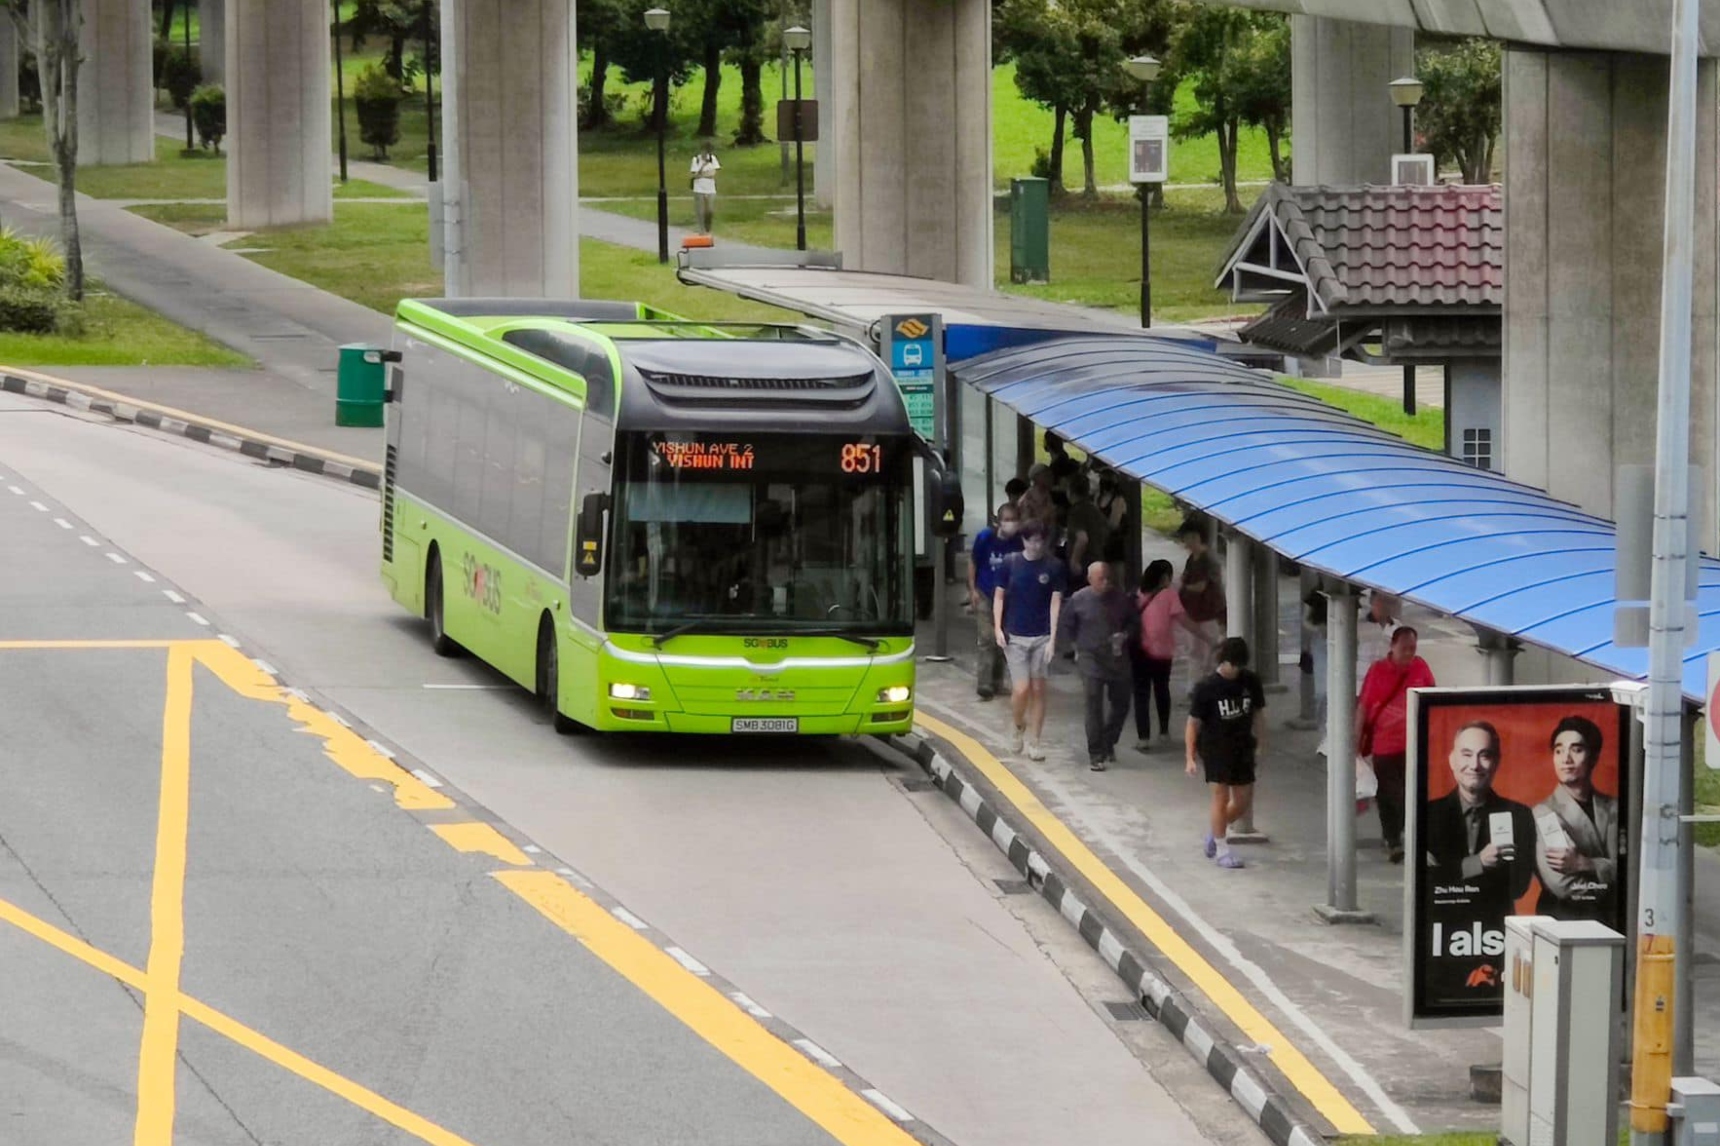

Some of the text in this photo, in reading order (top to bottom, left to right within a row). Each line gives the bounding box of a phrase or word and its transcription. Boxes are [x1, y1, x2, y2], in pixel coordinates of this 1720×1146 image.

[652, 441, 754, 455] YISHUN AVE 2
[841, 443, 880, 473] 851
[667, 454, 754, 469] YISHUN INT
[1644, 908, 1655, 928] 3
[1432, 922, 1442, 957] I
